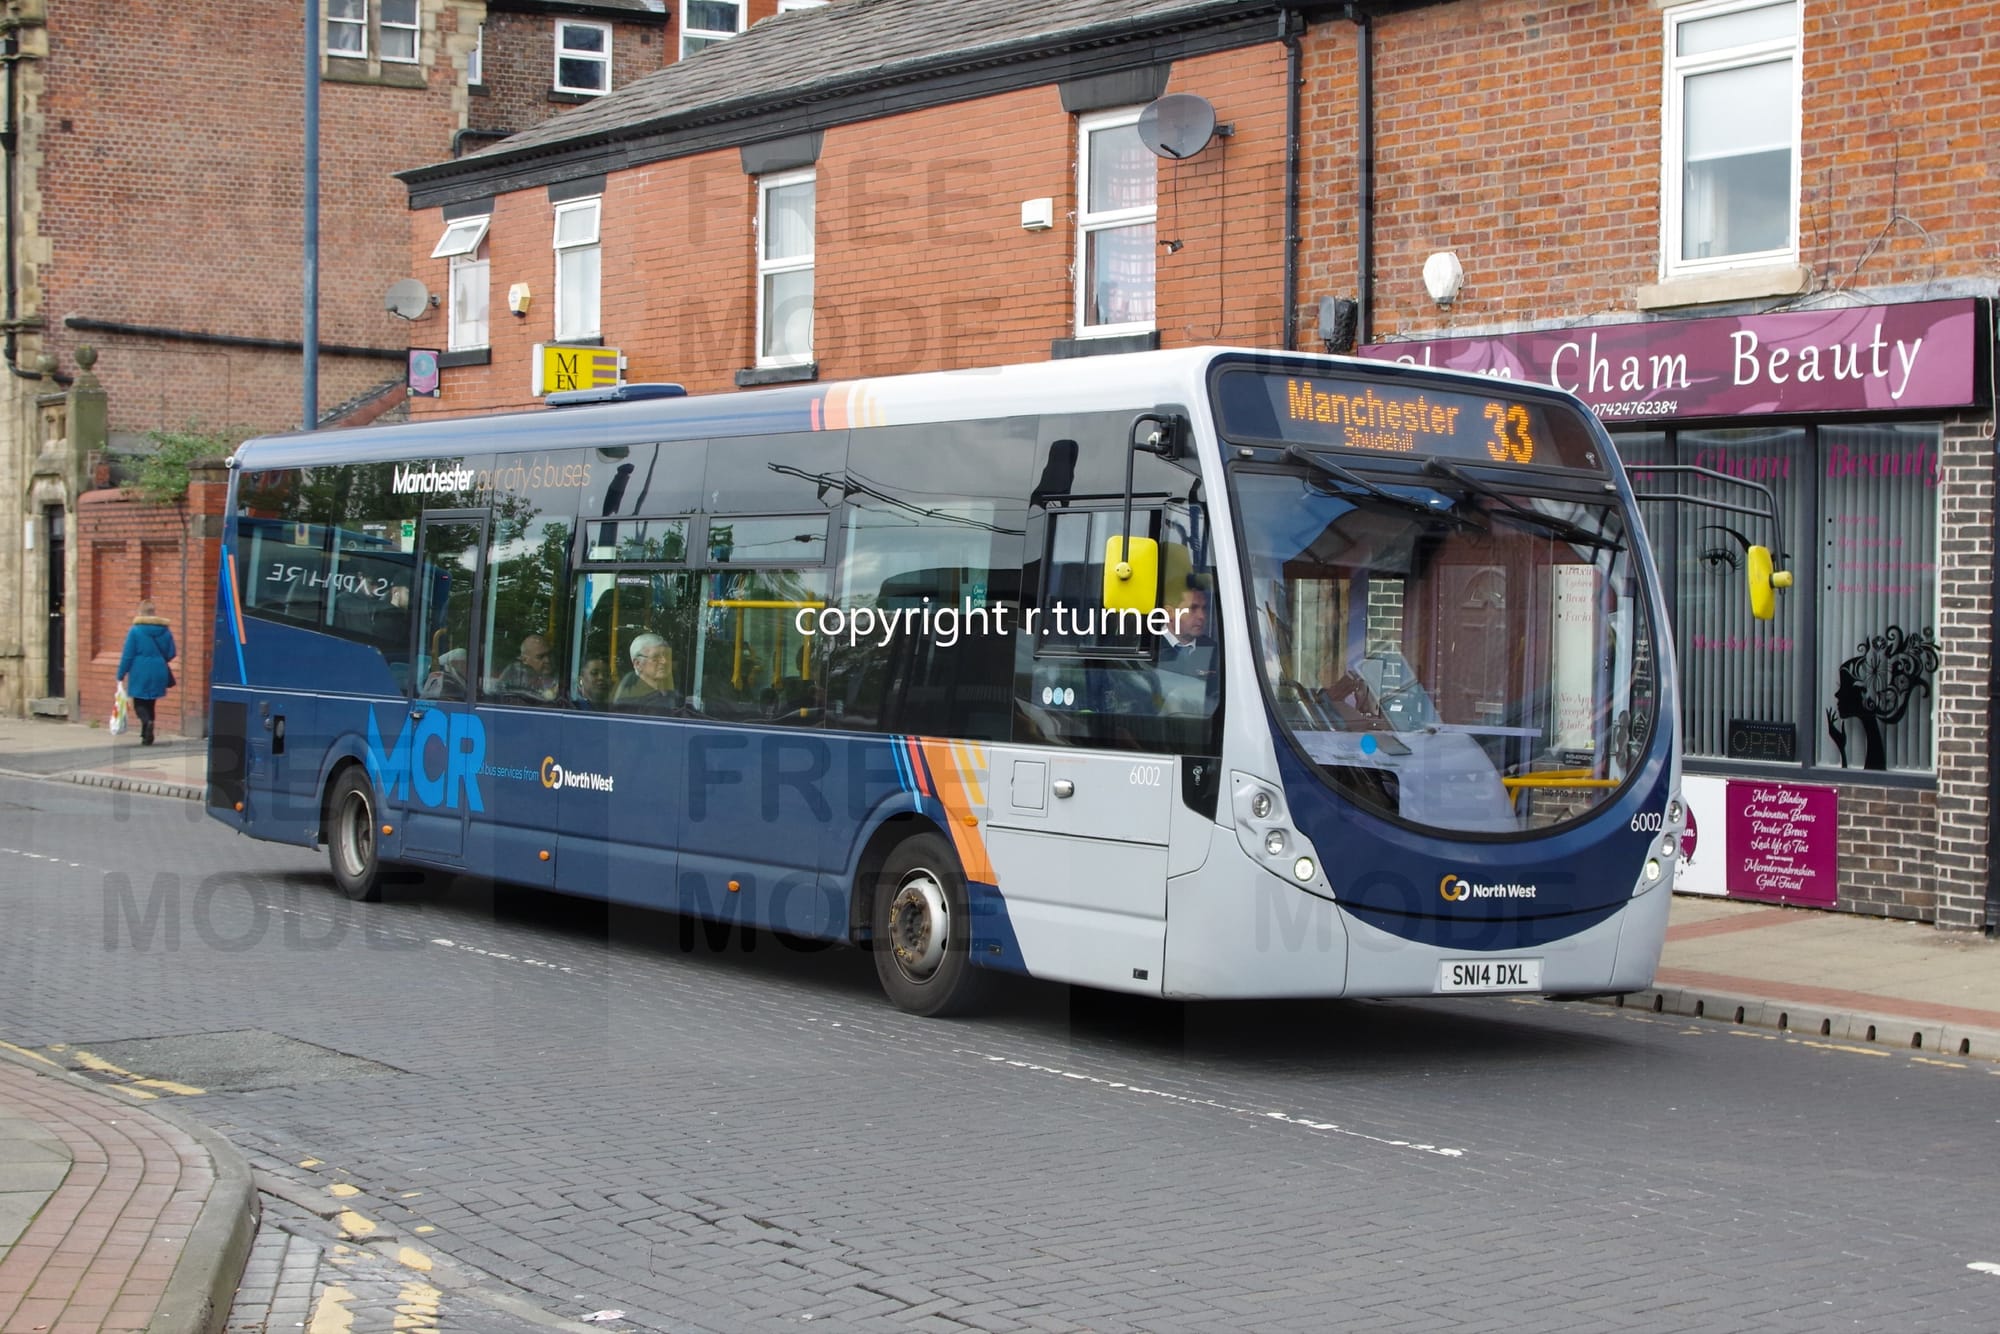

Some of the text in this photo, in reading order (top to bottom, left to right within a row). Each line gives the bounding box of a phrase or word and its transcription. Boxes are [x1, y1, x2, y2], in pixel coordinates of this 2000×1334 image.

[557, 353, 579, 374] M
[1551, 332, 1691, 394] Cham
[1730, 323, 1922, 399] Beauty
[557, 374, 579, 390] EN
[1591, 400, 1677, 416] 07424762384
[1287, 379, 1533, 464] Manchester 33
[392, 457, 592, 495] Manchester our city's buses
[1733, 730, 1791, 756] OPEN
[367, 702, 486, 813] MCR
[485, 764, 496, 776] bus
[523, 766, 539, 781] from
[564, 771, 590, 789] North
[590, 775, 614, 792] West
[1129, 766, 1161, 786] 6002
[1630, 812, 1661, 832] 6002
[1473, 884, 1506, 898] North
[1508, 884, 1537, 898] West
[1453, 964, 1528, 985] SN14 DXL
